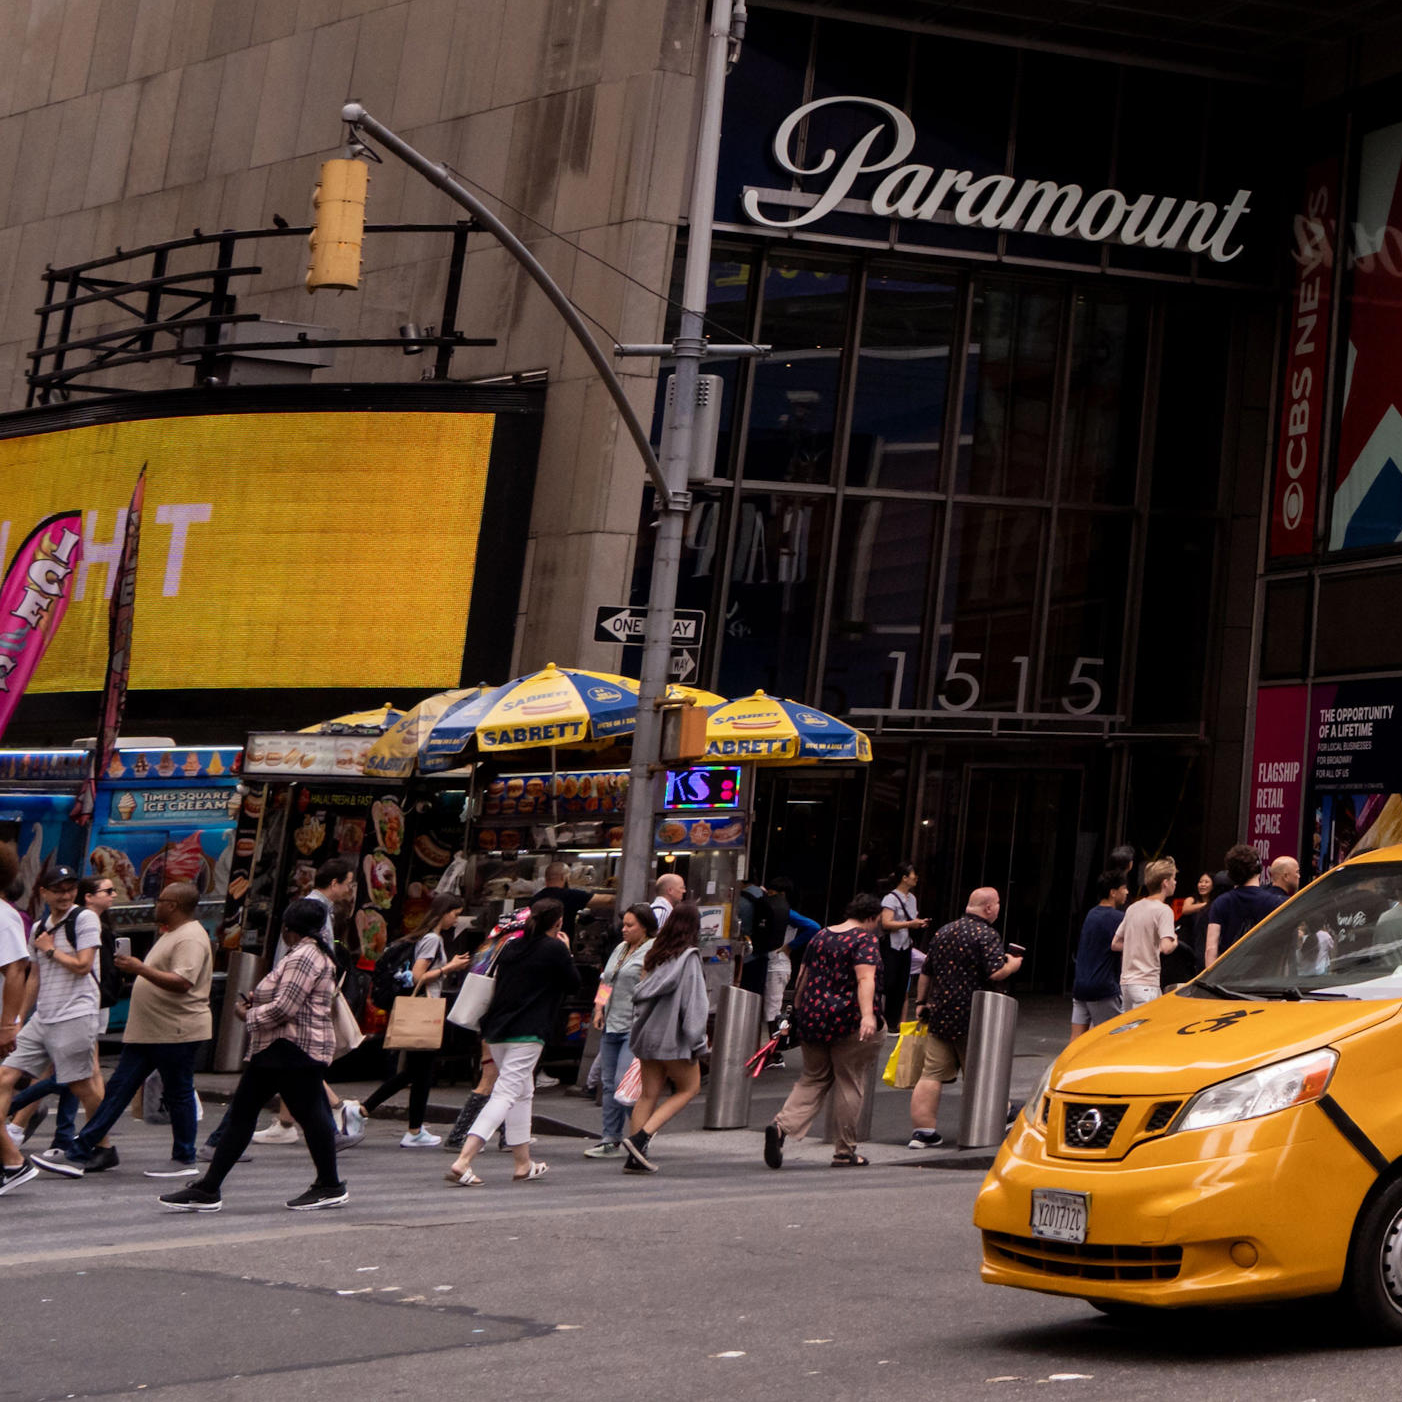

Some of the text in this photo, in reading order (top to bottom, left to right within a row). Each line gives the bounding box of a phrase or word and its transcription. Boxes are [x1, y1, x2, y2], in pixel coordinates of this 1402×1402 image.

[742, 95, 1252, 263] Paramount
[1285, 370, 1314, 482] CBS
[10, 526, 80, 630] ICE
[613, 618, 691, 636] ONE AY
[674, 659, 690, 672] WAY
[888, 652, 1104, 716] 1515
[502, 690, 569, 711] SABRETT
[712, 712, 779, 726] SABRETT
[1320, 705, 1394, 723] THE OPPORTUNITY
[483, 721, 584, 747] SABRETT
[1319, 723, 1373, 738] OF A LIFETIME
[703, 738, 791, 756] ABRETT
[1258, 762, 1300, 783] FLAGSHIP
[142, 790, 229, 802] TIMES SQUARE
[1256, 788, 1284, 809] RETAIL
[143, 800, 227, 813] ICE CREEAM
[1255, 814, 1280, 834] SPACE
